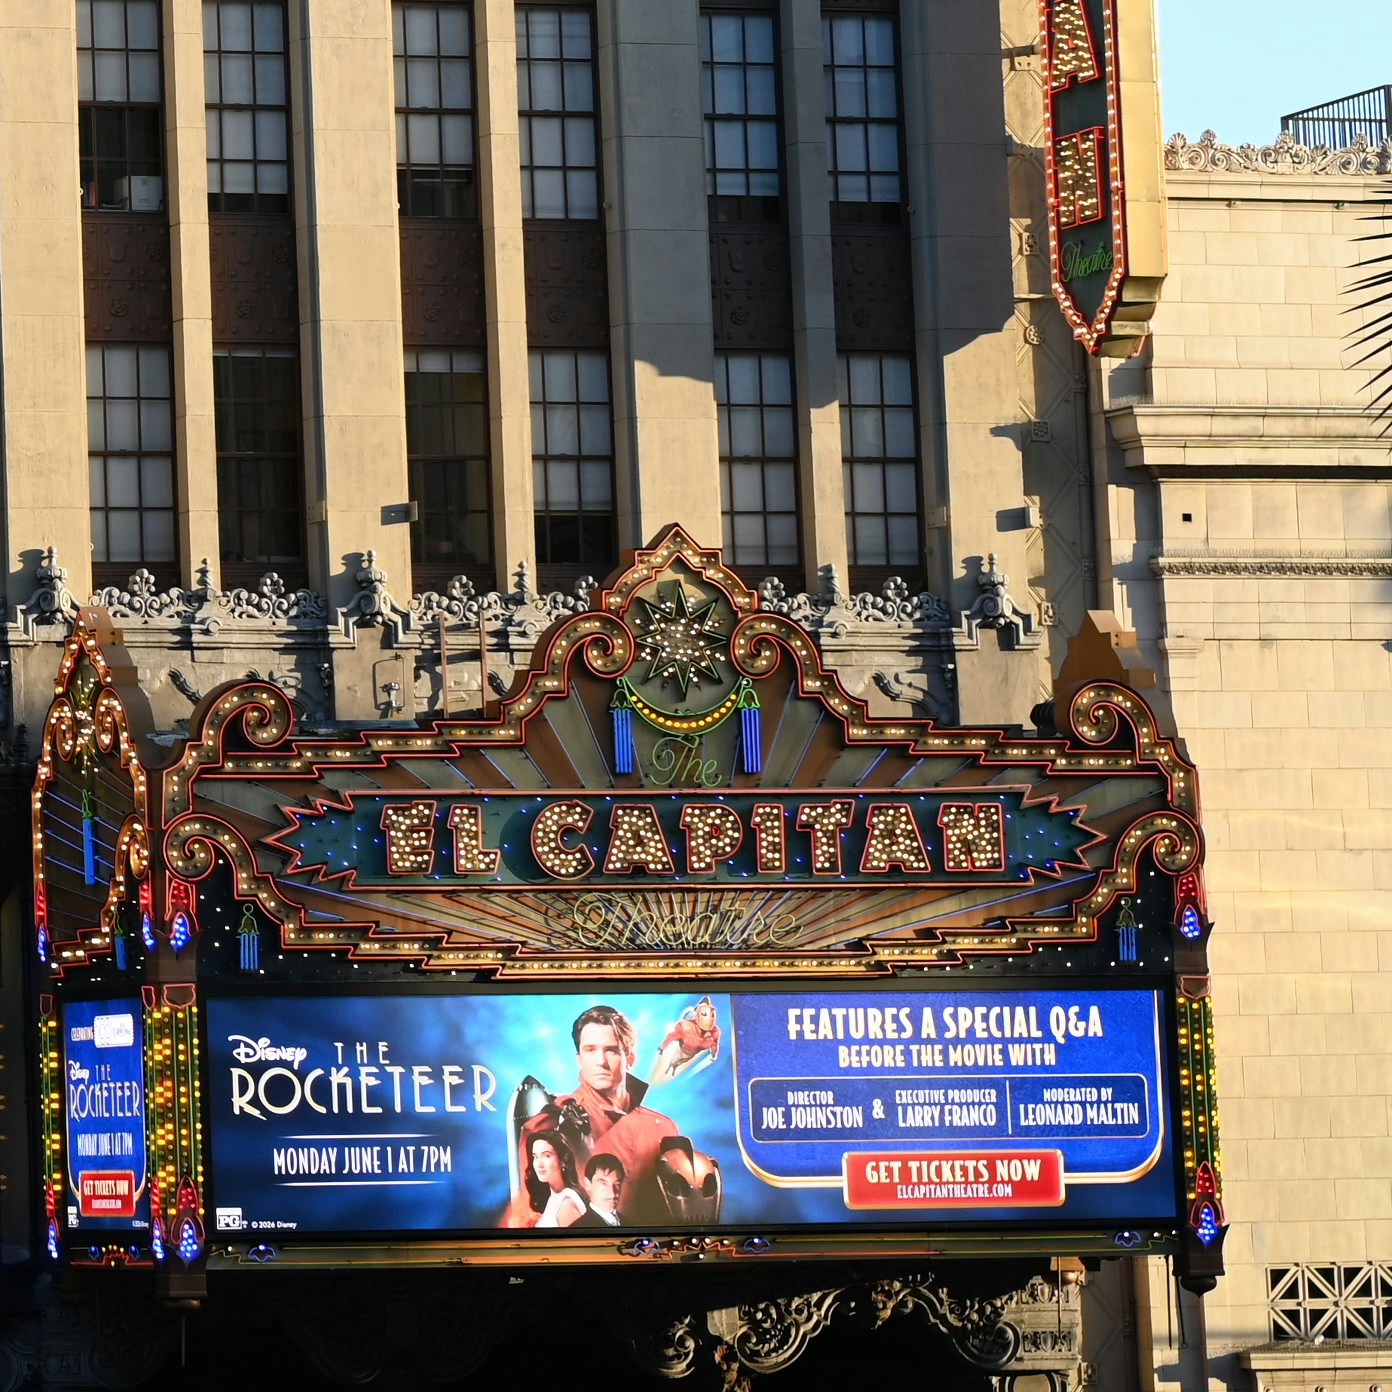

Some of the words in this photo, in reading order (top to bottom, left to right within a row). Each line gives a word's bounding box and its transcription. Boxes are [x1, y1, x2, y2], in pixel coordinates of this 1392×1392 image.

[1060, 241, 1114, 283] Theatre
[651, 736, 721, 786] The
[381, 800, 501, 875] EL
[530, 799, 1005, 880] CAPITAN
[571, 893, 804, 949] Theatre
[787, 1007, 913, 1040] FEATURES
[921, 1007, 937, 1039] A
[942, 1006, 1043, 1039] SPECIAL
[1049, 1005, 1104, 1044] Q&A
[227, 1034, 307, 1070] Disney
[333, 1041, 390, 1064] THE
[838, 1045, 906, 1068] BEFORE
[909, 1045, 944, 1067] THE
[948, 1044, 1004, 1067] MOVIE
[1007, 1043, 1056, 1066] WITH
[95, 1064, 111, 1081] THE
[70, 1081, 141, 1122] ROCKETEER
[229, 1064, 497, 1121] ROCKETEER
[787, 1091, 835, 1106] DIRECTOR
[895, 1089, 946, 1105] EXECUTIVE
[947, 1089, 997, 1104] PRODUCER
[1043, 1088, 1099, 1103] MODERATED
[1101, 1088, 1113, 1102] BY
[761, 1107, 787, 1130] JOE
[789, 1106, 864, 1130] JOHNSTON
[871, 1098, 886, 1120] &
[897, 1105, 941, 1128] LARRY
[944, 1105, 997, 1127] FRANCO
[1019, 1104, 1084, 1126] LEONARD
[1086, 1103, 1139, 1126] MALTIN
[273, 1147, 338, 1175] MONDAY
[342, 1147, 382, 1174] JUNE
[386, 1147, 393, 1174] 1
[398, 1146, 416, 1173] AT
[421, 1145, 452, 1173] 7PM
[865, 1161, 902, 1185] GET
[907, 1160, 989, 1185] TICKETS
[994, 1159, 1042, 1183] NOW
[84, 1180, 94, 1196] GET
[95, 1180, 115, 1196] TICKETS
[896, 1183, 1013, 1199] ELCAPITANTHEATRE.COM
[218, 1215, 240, 1228] PG
